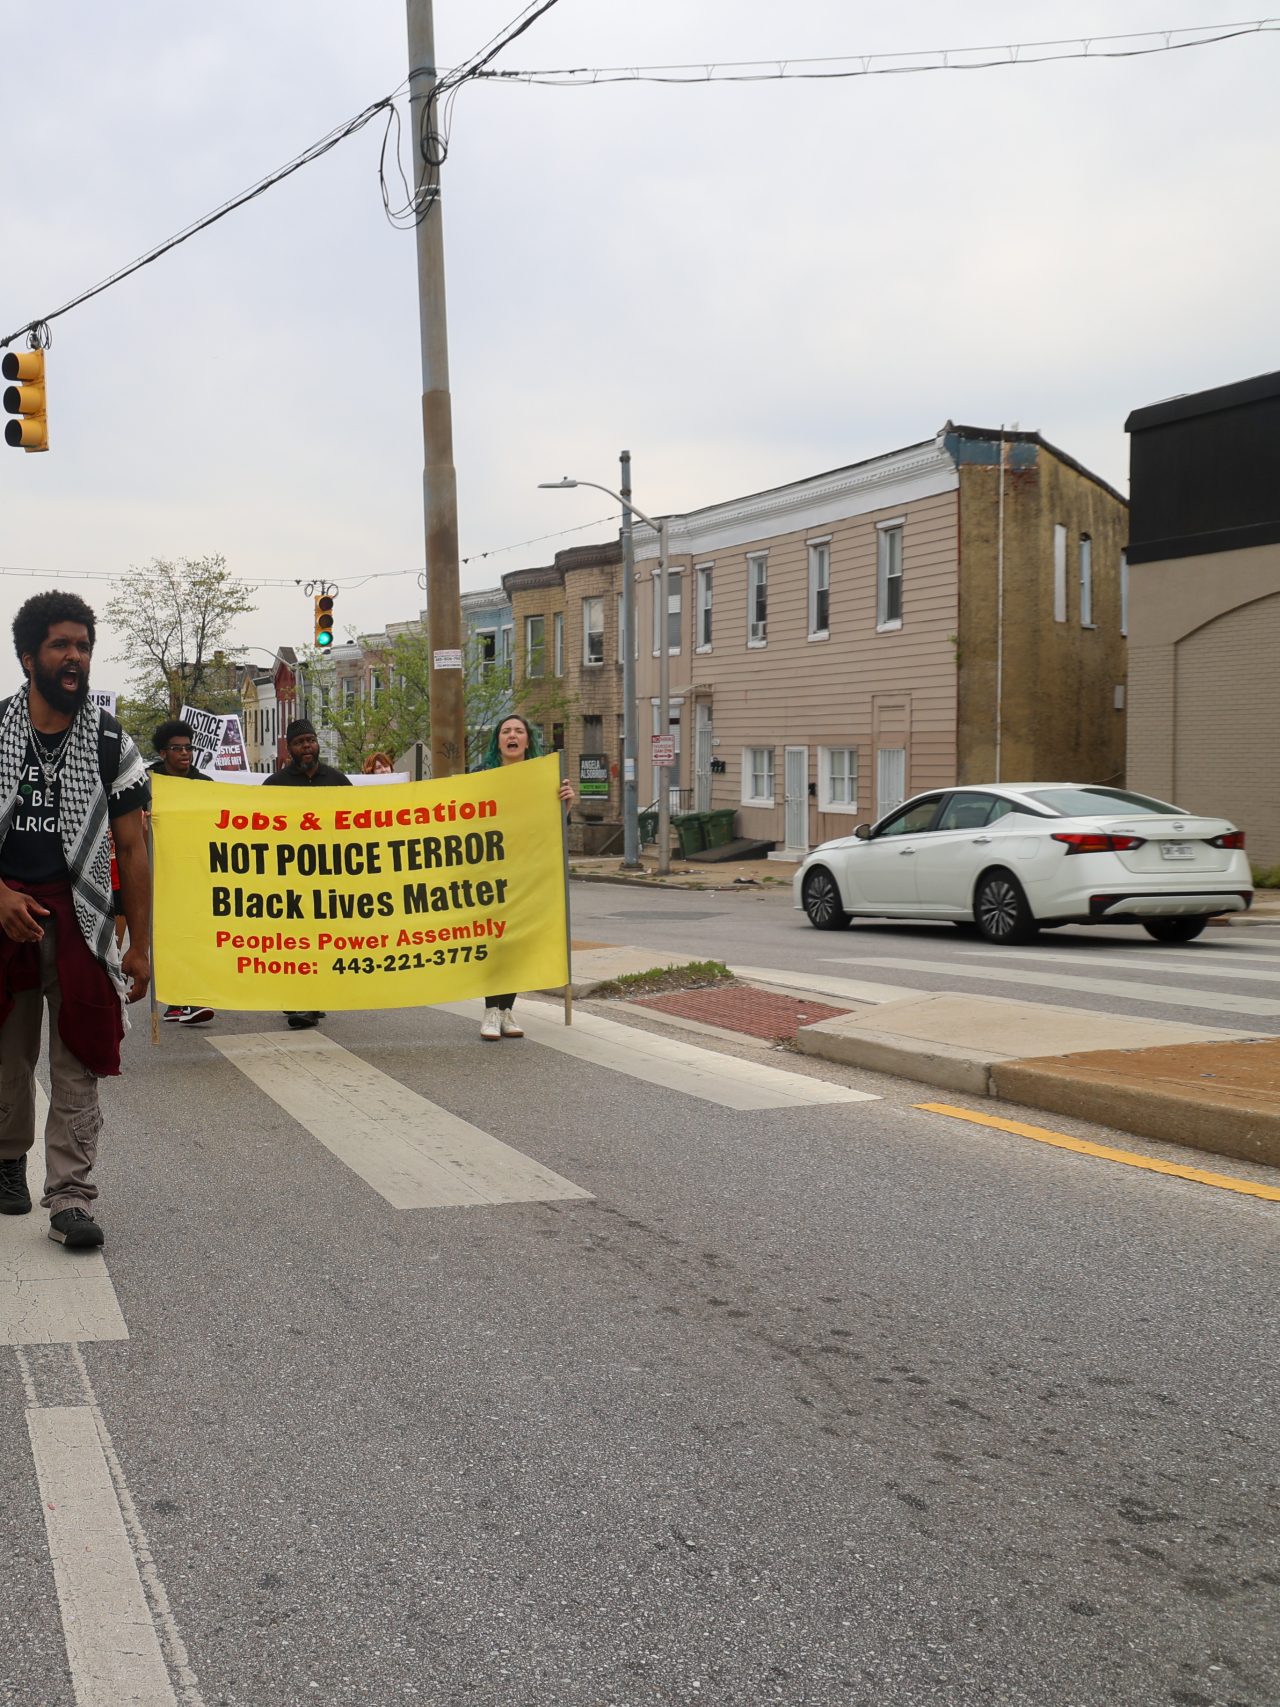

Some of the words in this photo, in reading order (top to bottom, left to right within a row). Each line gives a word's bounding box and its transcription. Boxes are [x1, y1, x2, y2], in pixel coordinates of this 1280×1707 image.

[184, 708, 224, 737] JUSTICE
[31, 790, 55, 808] BE
[11, 815, 61, 833] LRIG
[214, 809, 288, 832] Jobs
[299, 812, 322, 832] &
[334, 799, 498, 831] Education
[208, 841, 270, 875] NOT
[276, 841, 381, 876] POLICE
[387, 830, 505, 872] TERROR
[212, 886, 304, 920] Black
[312, 888, 395, 920] Lives
[403, 877, 509, 915] Matter
[215, 930, 311, 953] Peoples
[317, 931, 389, 951] Power
[395, 917, 507, 949] Assembly
[236, 956, 319, 976] Phone:
[331, 944, 489, 975] 443-221-3775
